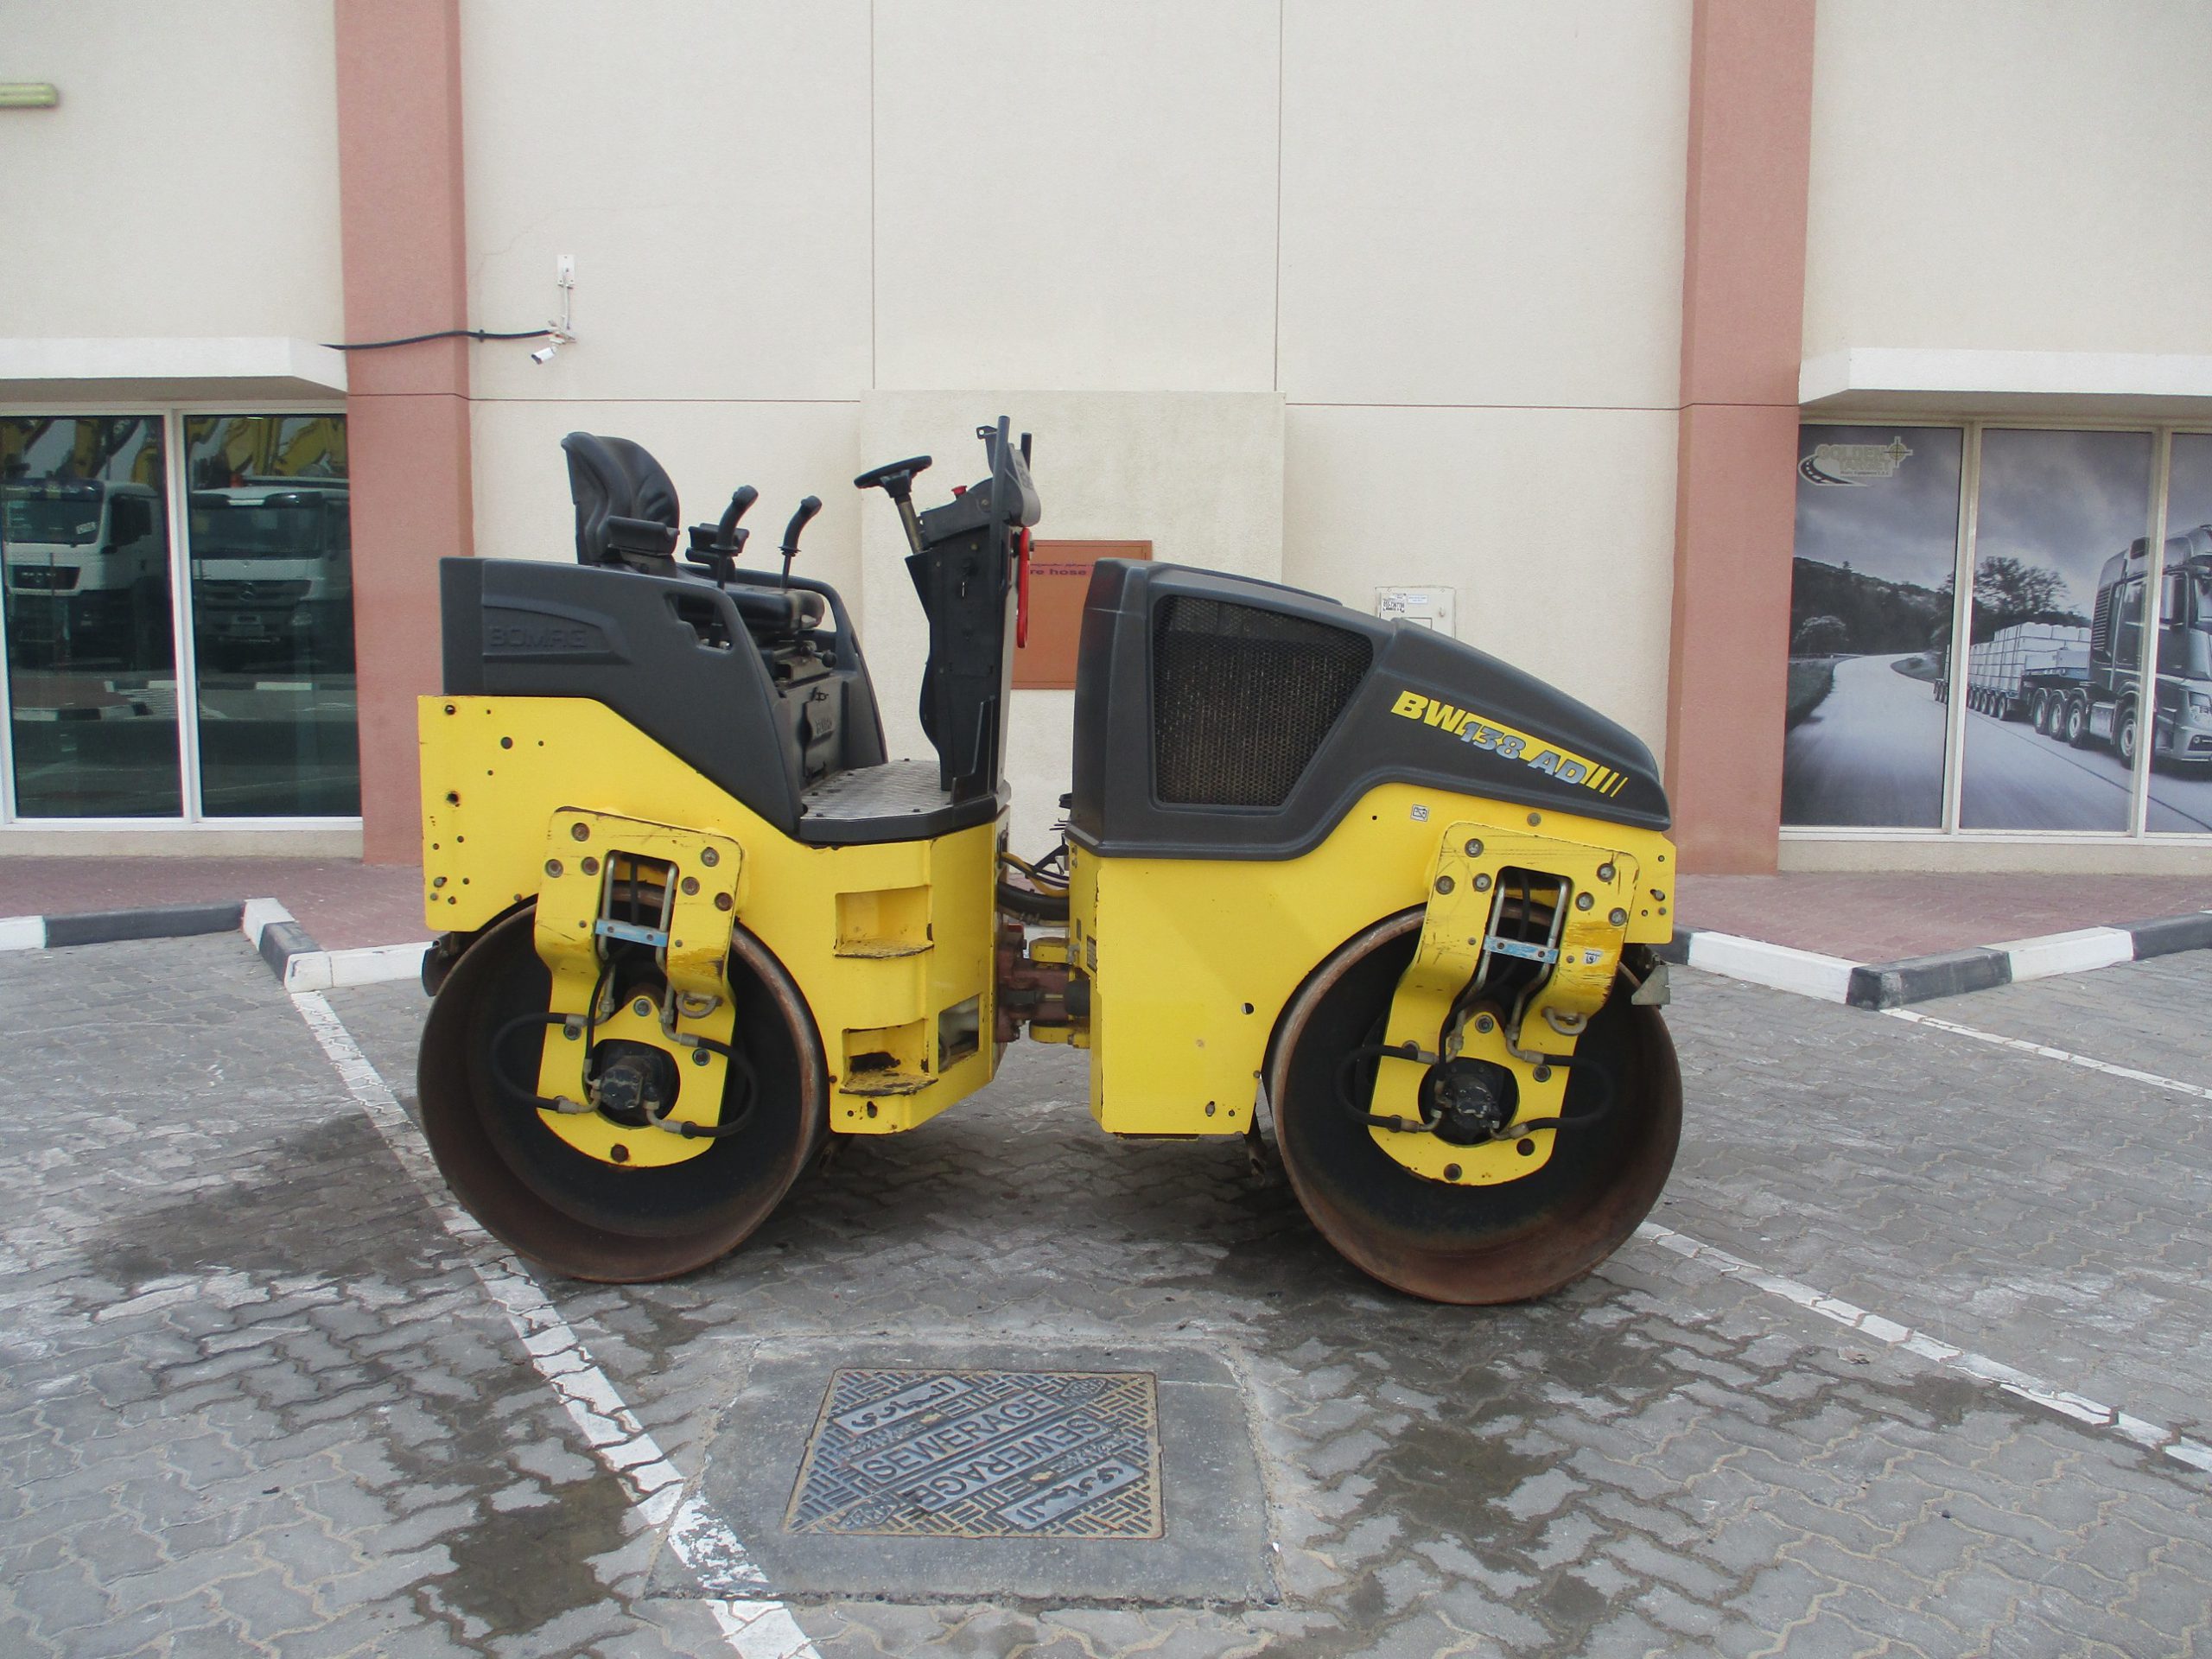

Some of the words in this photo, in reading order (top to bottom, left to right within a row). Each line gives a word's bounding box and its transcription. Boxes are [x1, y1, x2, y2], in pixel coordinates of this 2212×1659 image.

[489, 627, 588, 648] BOMAG
[1527, 749, 1587, 785] AD
[861, 1393, 1056, 1484] SEWERAGE
[914, 1416, 1102, 1510] SEWERAGE
